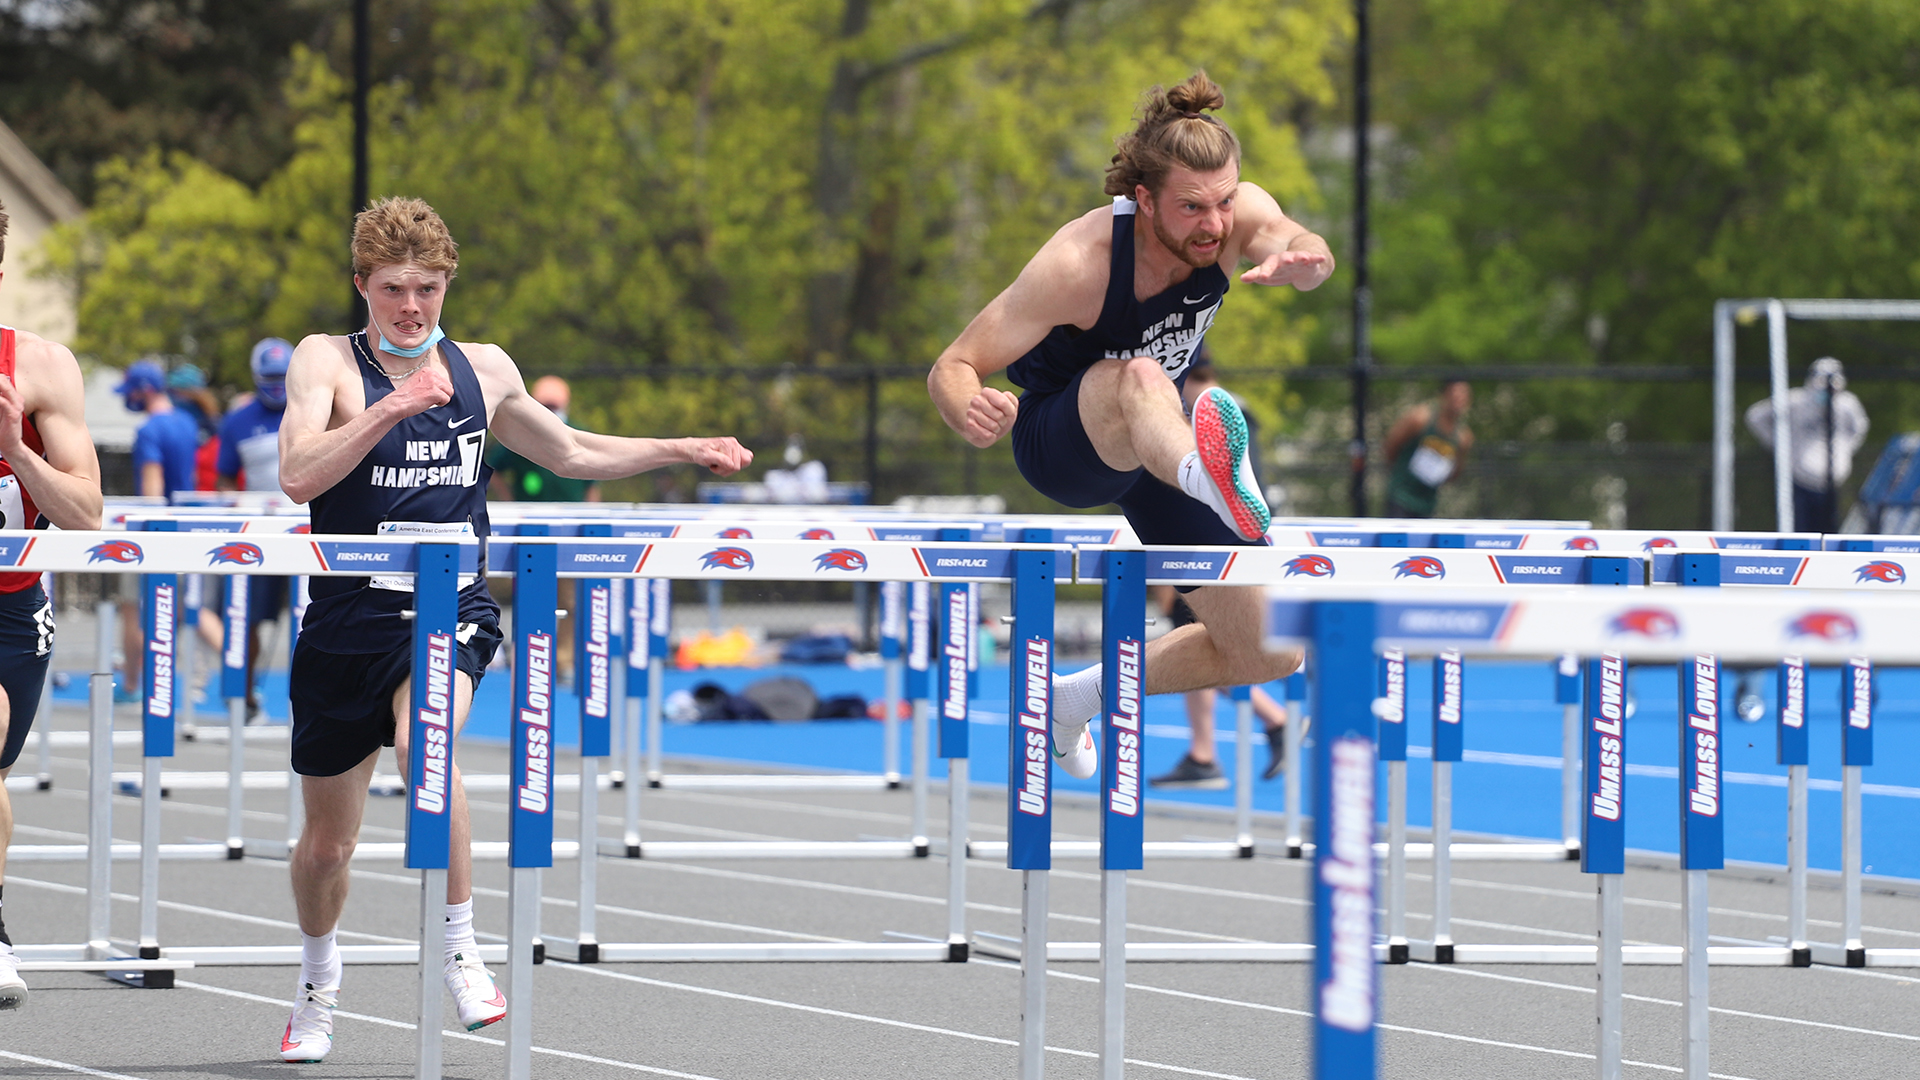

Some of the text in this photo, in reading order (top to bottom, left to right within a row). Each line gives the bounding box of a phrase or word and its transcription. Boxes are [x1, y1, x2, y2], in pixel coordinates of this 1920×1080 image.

[1104, 328, 1195, 360] HAMPSHI
[1141, 313, 1184, 343] NEW
[370, 465, 463, 488] HAMPSHIR
[405, 440, 450, 461] NEW
[466, 434, 482, 482] 7
[149, 654, 172, 717] UMASS
[585, 654, 608, 718] UMASS
[944, 657, 967, 720] UMASS
[1439, 661, 1461, 725] UMASS
[1782, 666, 1804, 729] UMASS
[1849, 667, 1870, 730] UMASS
[415, 633, 452, 815] UMASS LOWELL
[518, 633, 552, 815] UMASS LOWELL
[1017, 639, 1050, 817] UMASS LOWELL
[1109, 639, 1141, 817] UMASS LOWELL
[1689, 651, 1719, 818] UMASS LOWEL
[1592, 734, 1622, 822] UMASS
